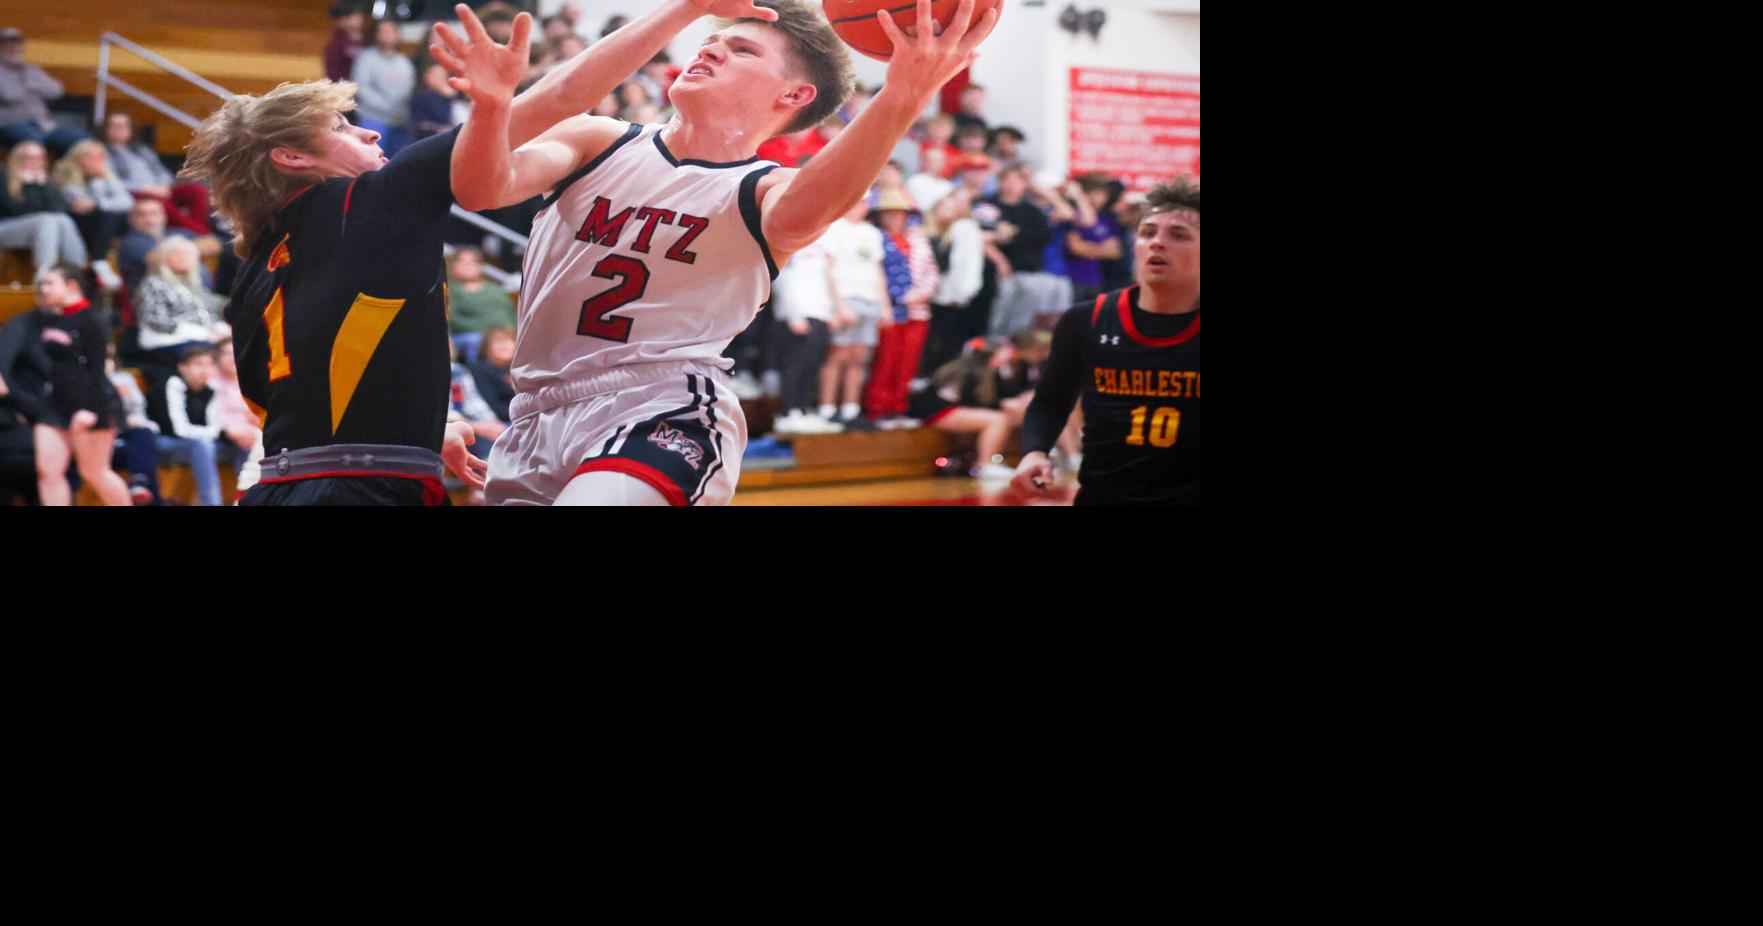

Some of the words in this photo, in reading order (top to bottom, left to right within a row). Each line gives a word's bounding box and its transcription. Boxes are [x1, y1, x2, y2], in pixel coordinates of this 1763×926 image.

[575, 195, 709, 264] MTZ
[262, 285, 292, 382] 1
[576, 253, 651, 343] 2
[1125, 405, 1180, 448] 10
